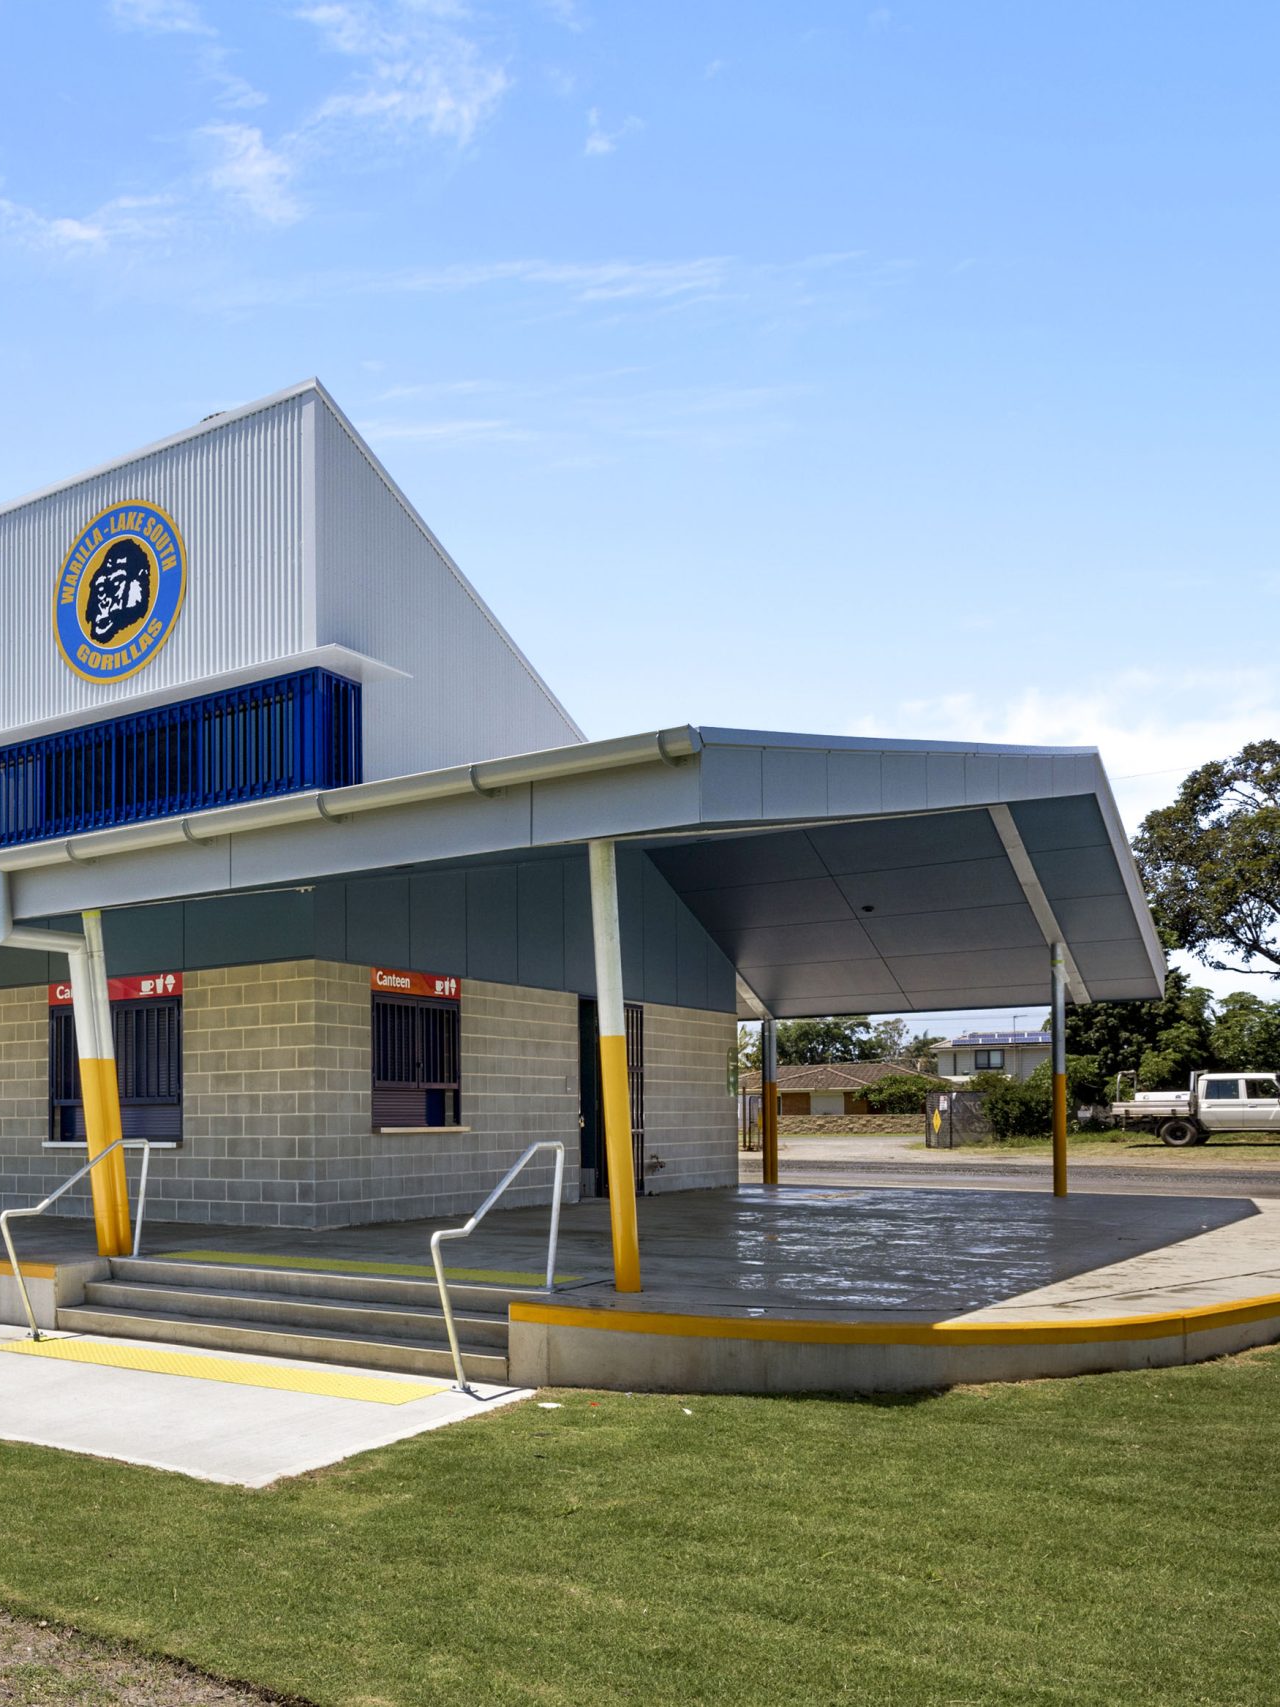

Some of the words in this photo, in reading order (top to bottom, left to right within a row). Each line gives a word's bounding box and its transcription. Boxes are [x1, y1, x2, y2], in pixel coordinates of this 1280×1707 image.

[143, 517, 177, 572] SOUTH
[76, 618, 162, 670] GORILLAS
[376, 971, 411, 988] Canteen
